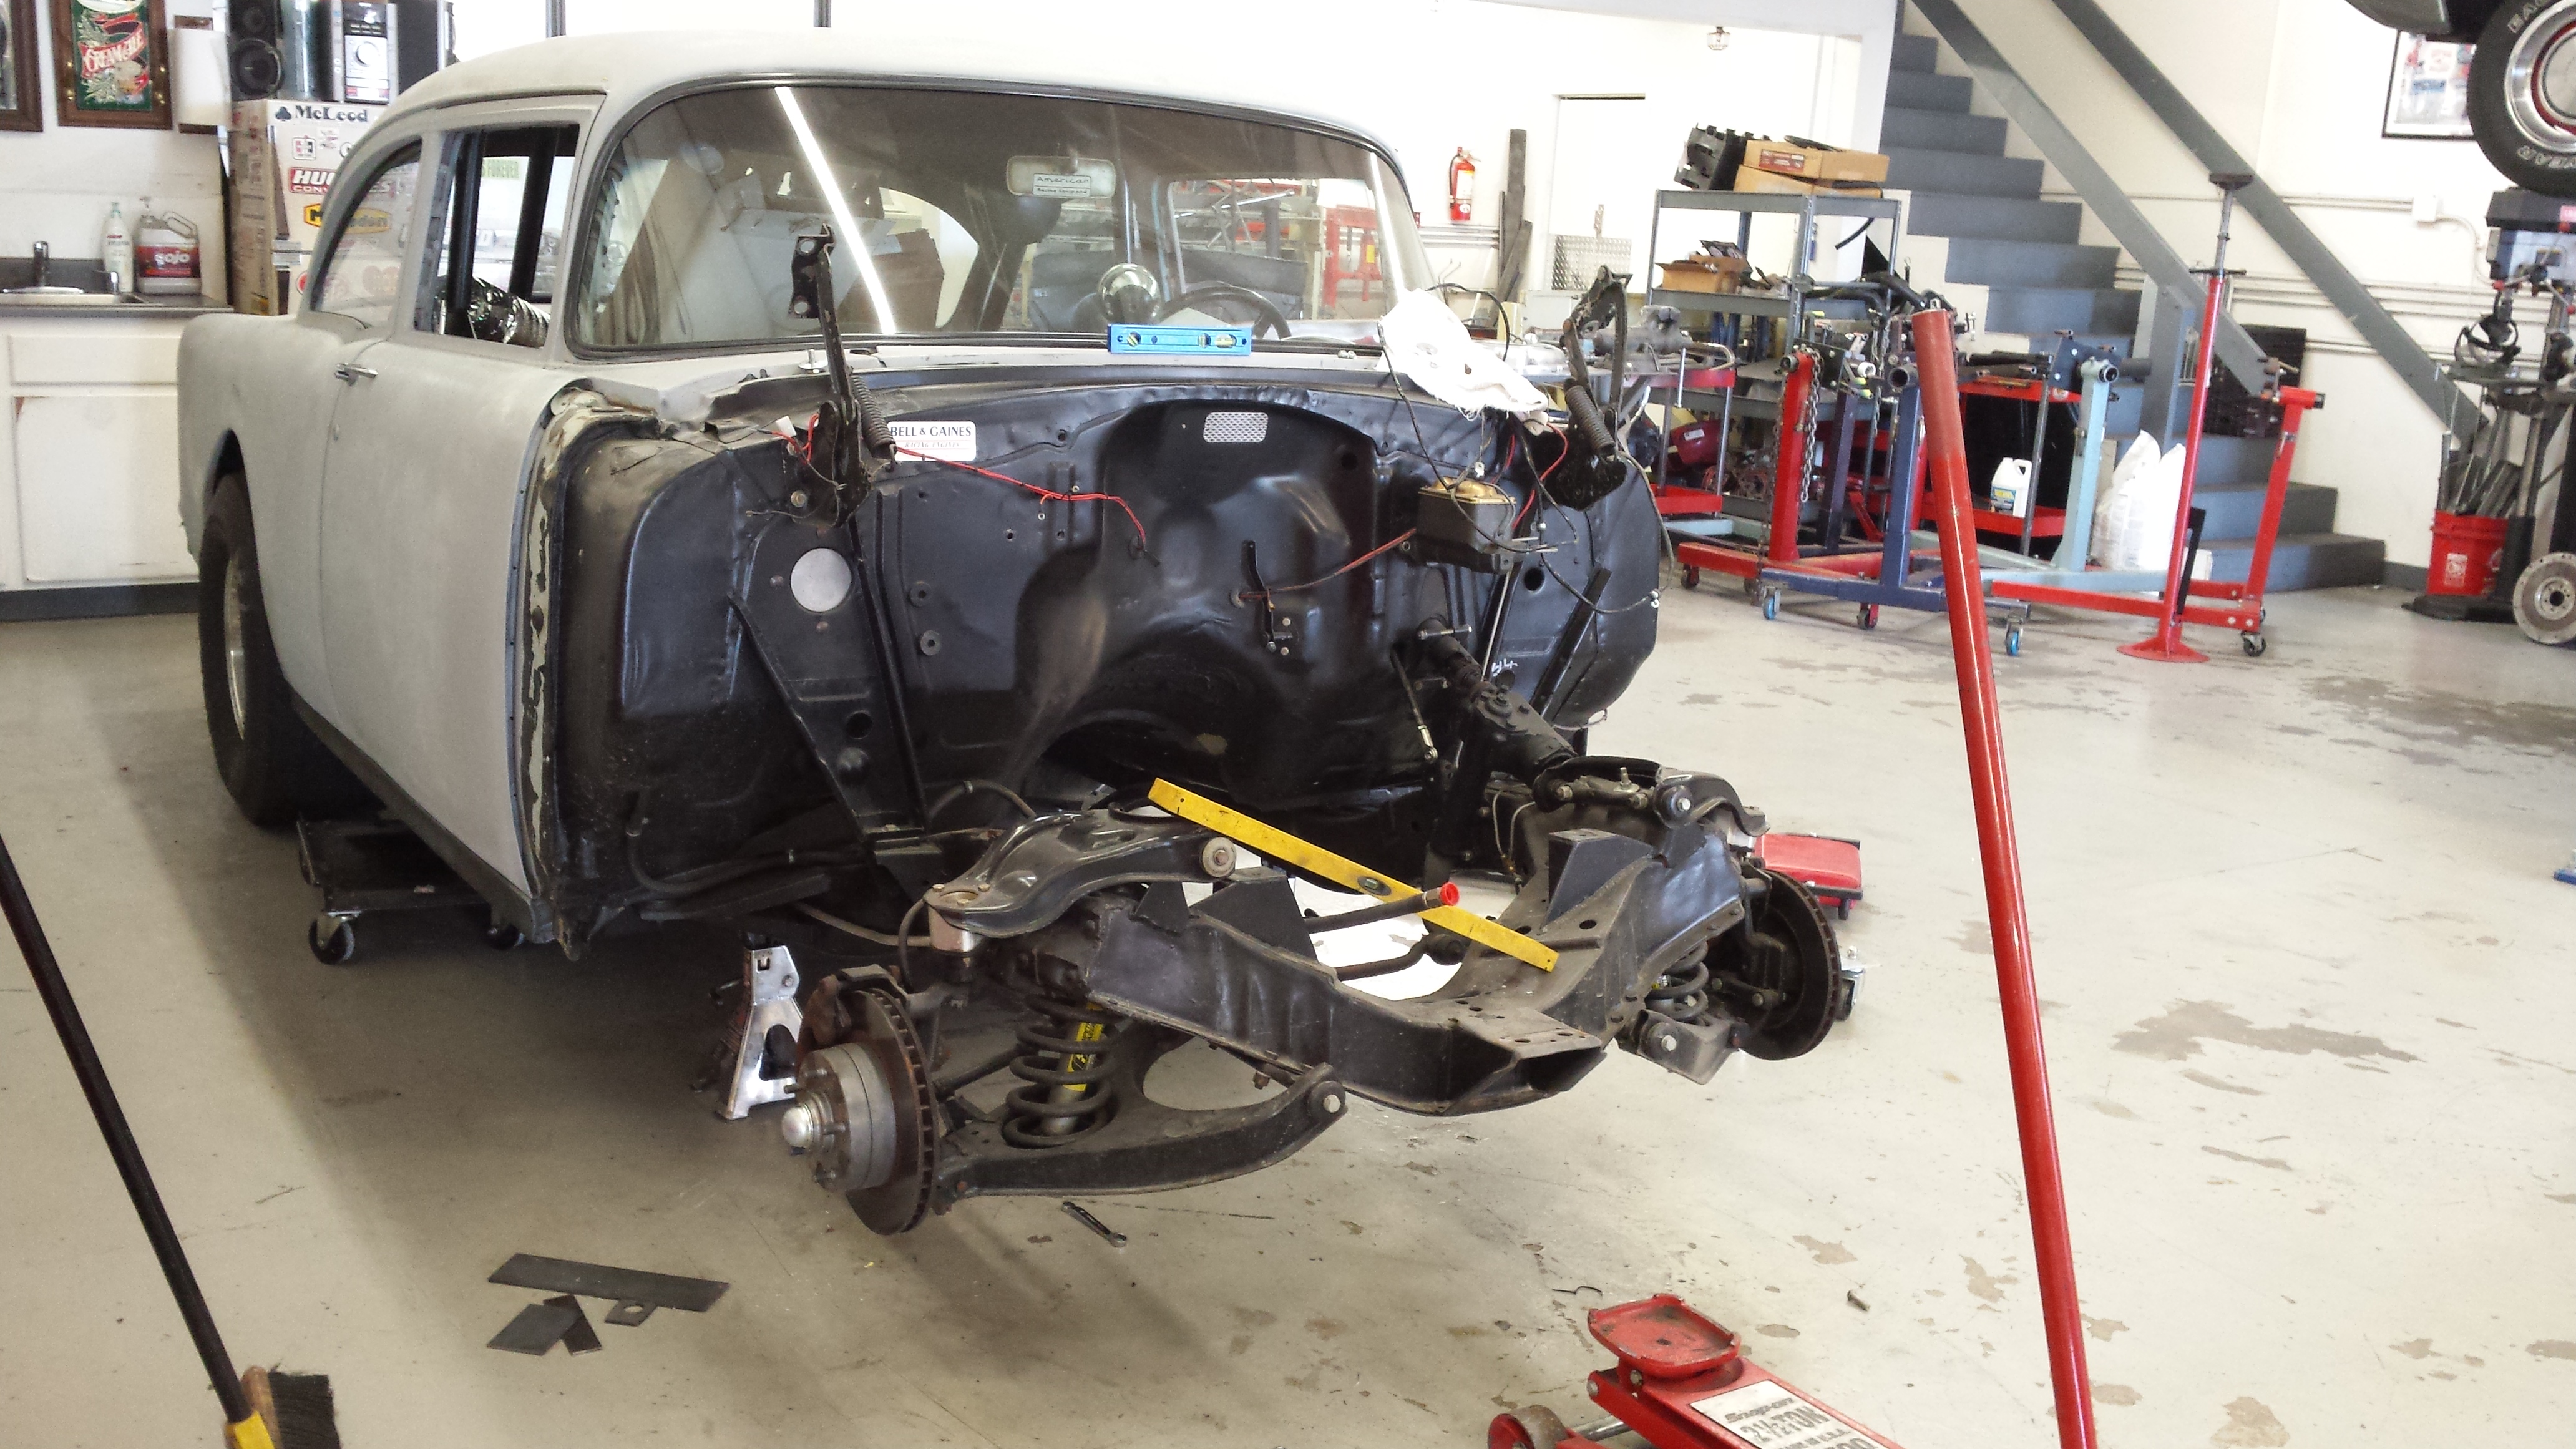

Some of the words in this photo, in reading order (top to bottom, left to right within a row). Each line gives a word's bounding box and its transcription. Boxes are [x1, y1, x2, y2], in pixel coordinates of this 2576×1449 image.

[295, 105, 368, 122] McLeod
[487, 159, 519, 179] FOREVER
[1037, 176, 1089, 184] American
[890, 426, 917, 437] BELL
[919, 427, 926, 436] &
[930, 426, 972, 437] GAINES
